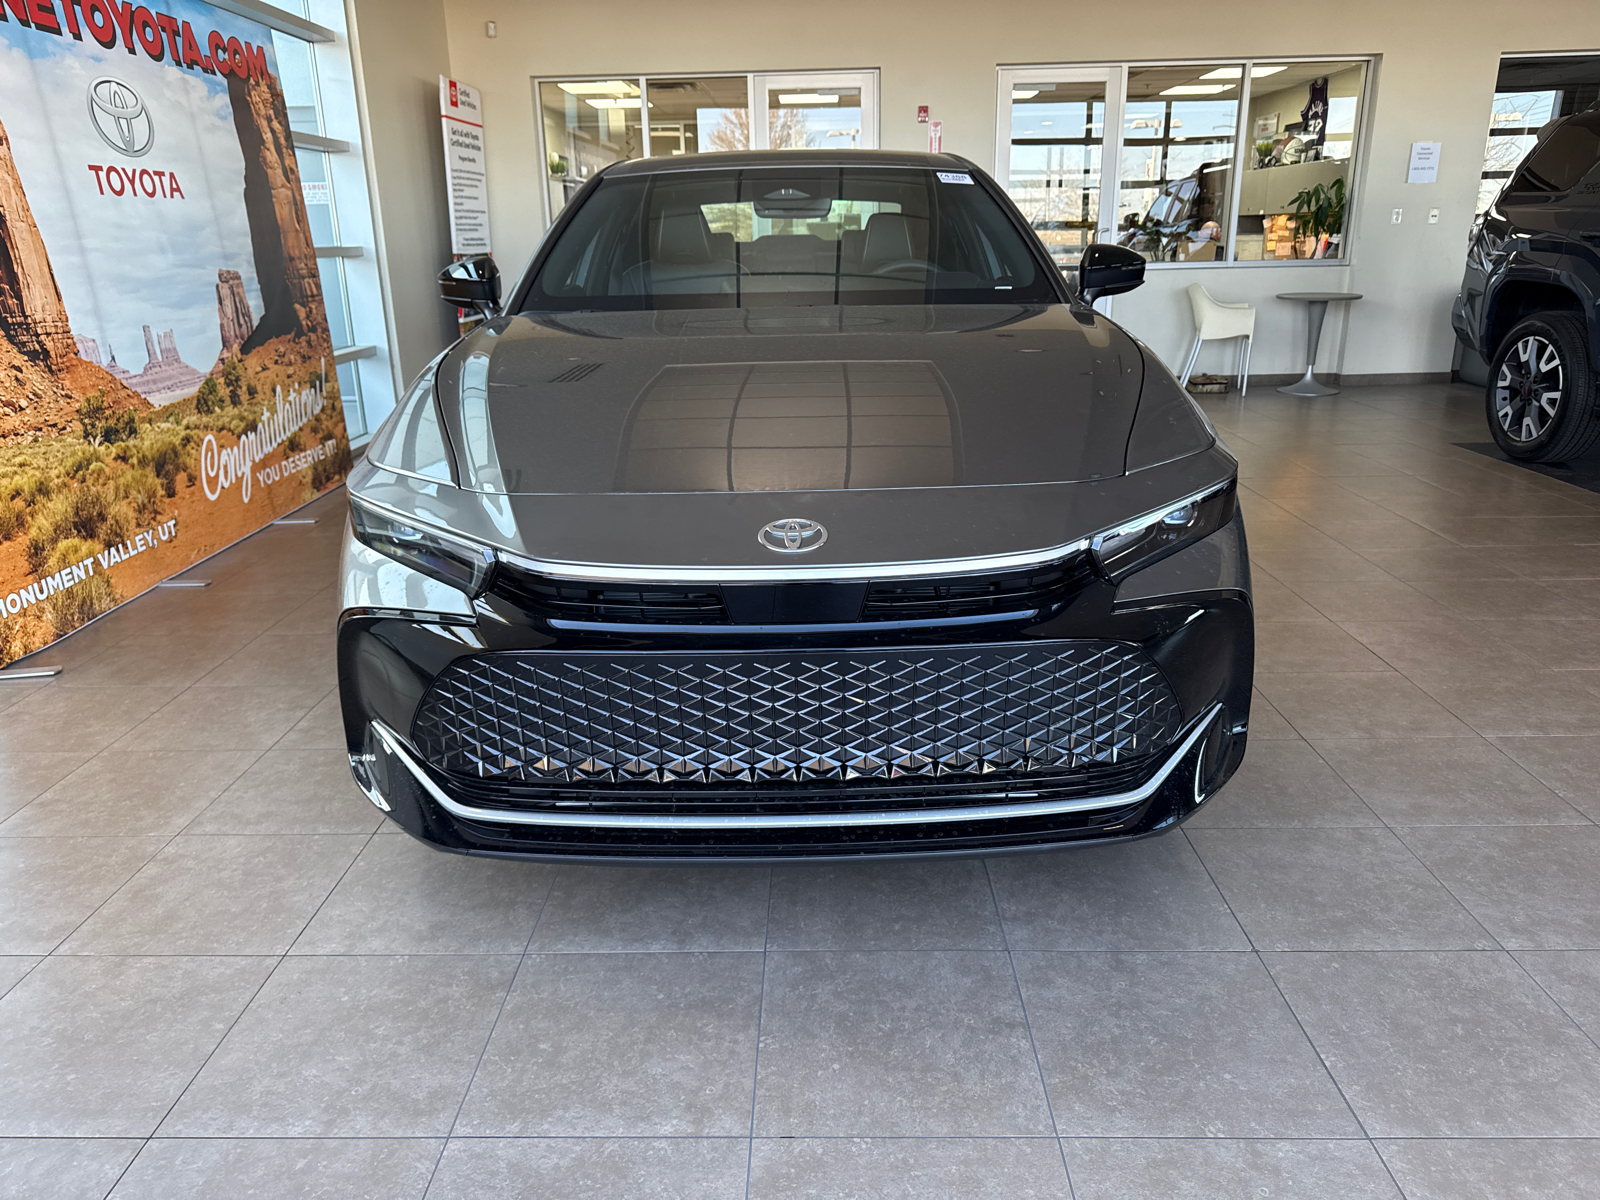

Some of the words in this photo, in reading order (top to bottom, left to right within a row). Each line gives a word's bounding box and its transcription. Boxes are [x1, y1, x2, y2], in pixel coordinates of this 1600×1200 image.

[87, 164, 185, 199] TOYOTA
[201, 356, 327, 503] Congratulations!
[256, 463, 281, 488] YOU
[282, 444, 326, 477] DESERVE
[325, 438, 338, 457] IT!
[96, 529, 158, 570] VALLEY,
[157, 519, 177, 541] UT
